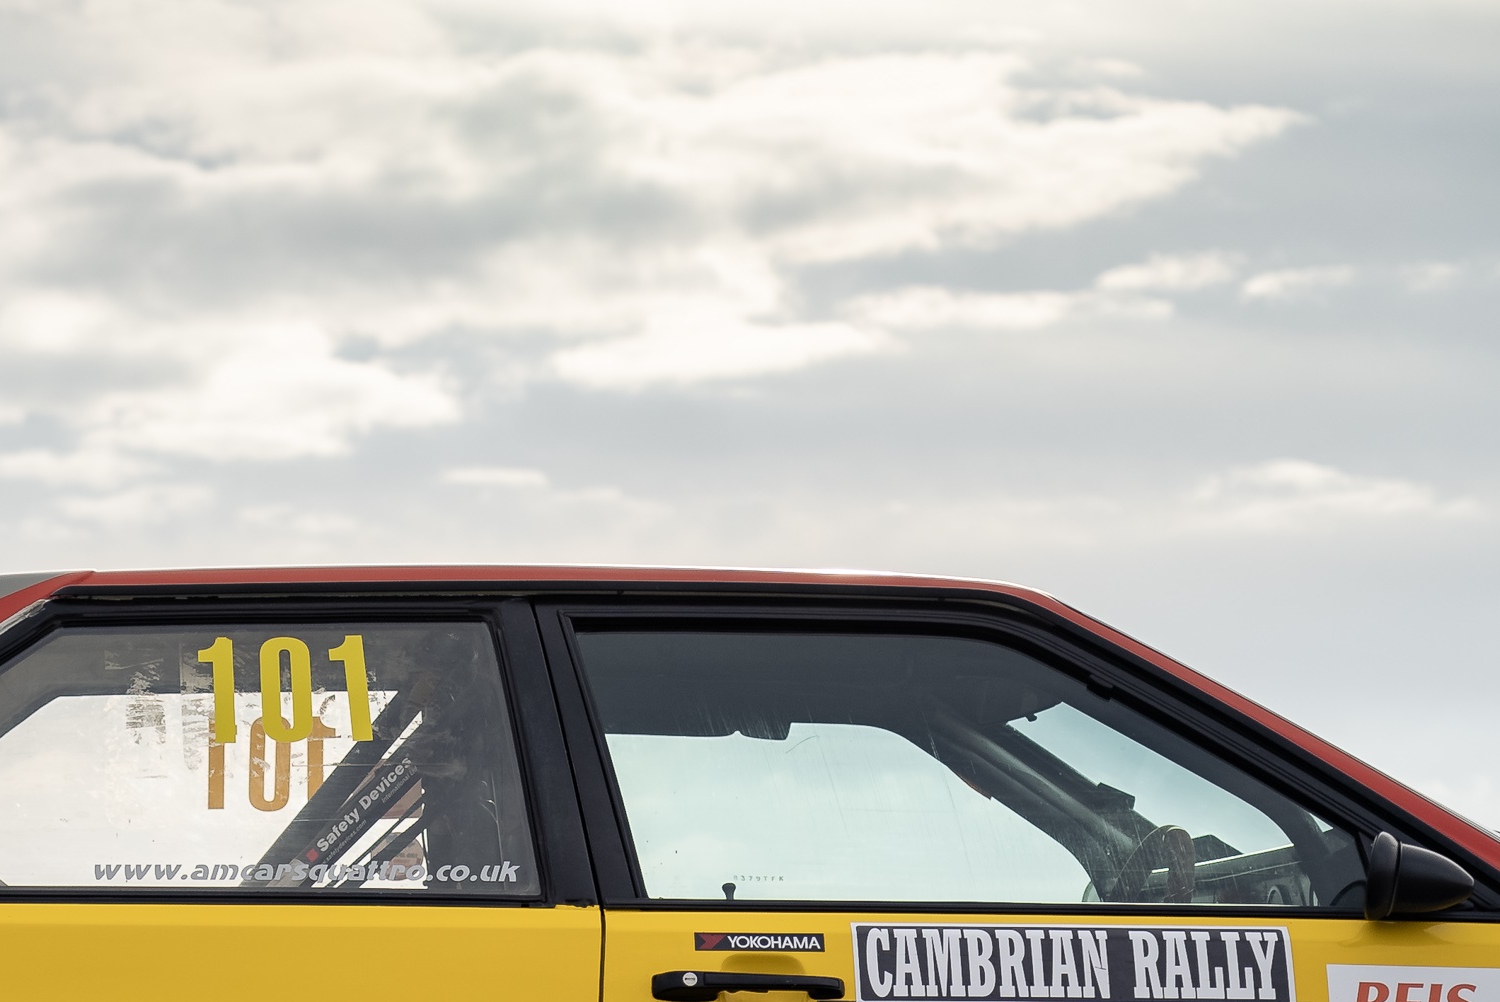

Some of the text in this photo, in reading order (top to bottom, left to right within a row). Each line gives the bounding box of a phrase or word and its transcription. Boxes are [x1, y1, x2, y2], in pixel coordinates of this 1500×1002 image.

[197, 634, 374, 743] 101
[316, 757, 412, 852] Safety Devices
[94, 860, 520, 884] www.amcarsquattro.co.uk
[727, 935, 821, 950] YOKOHAMA
[866, 927, 1279, 1000] CAMBRIAN RALLY
